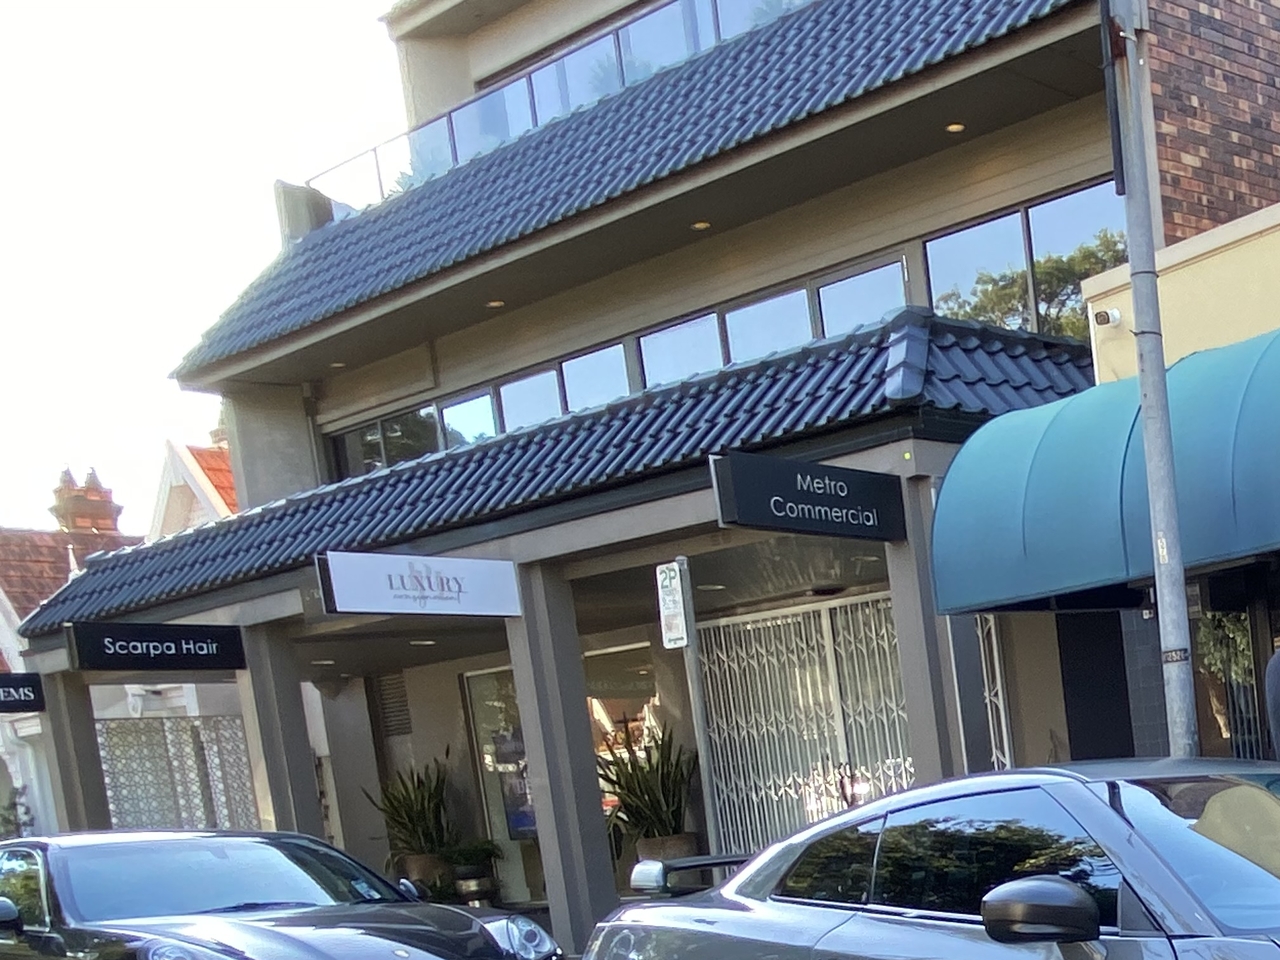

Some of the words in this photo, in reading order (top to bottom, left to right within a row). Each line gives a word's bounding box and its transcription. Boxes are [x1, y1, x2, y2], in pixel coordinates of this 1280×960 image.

[796, 473, 848, 497] Metro
[770, 496, 879, 527] Commercial
[387, 573, 468, 595] LUXURY
[660, 567, 678, 589] 2P
[104, 638, 176, 658] Scarpa
[181, 638, 219, 655] Hair
